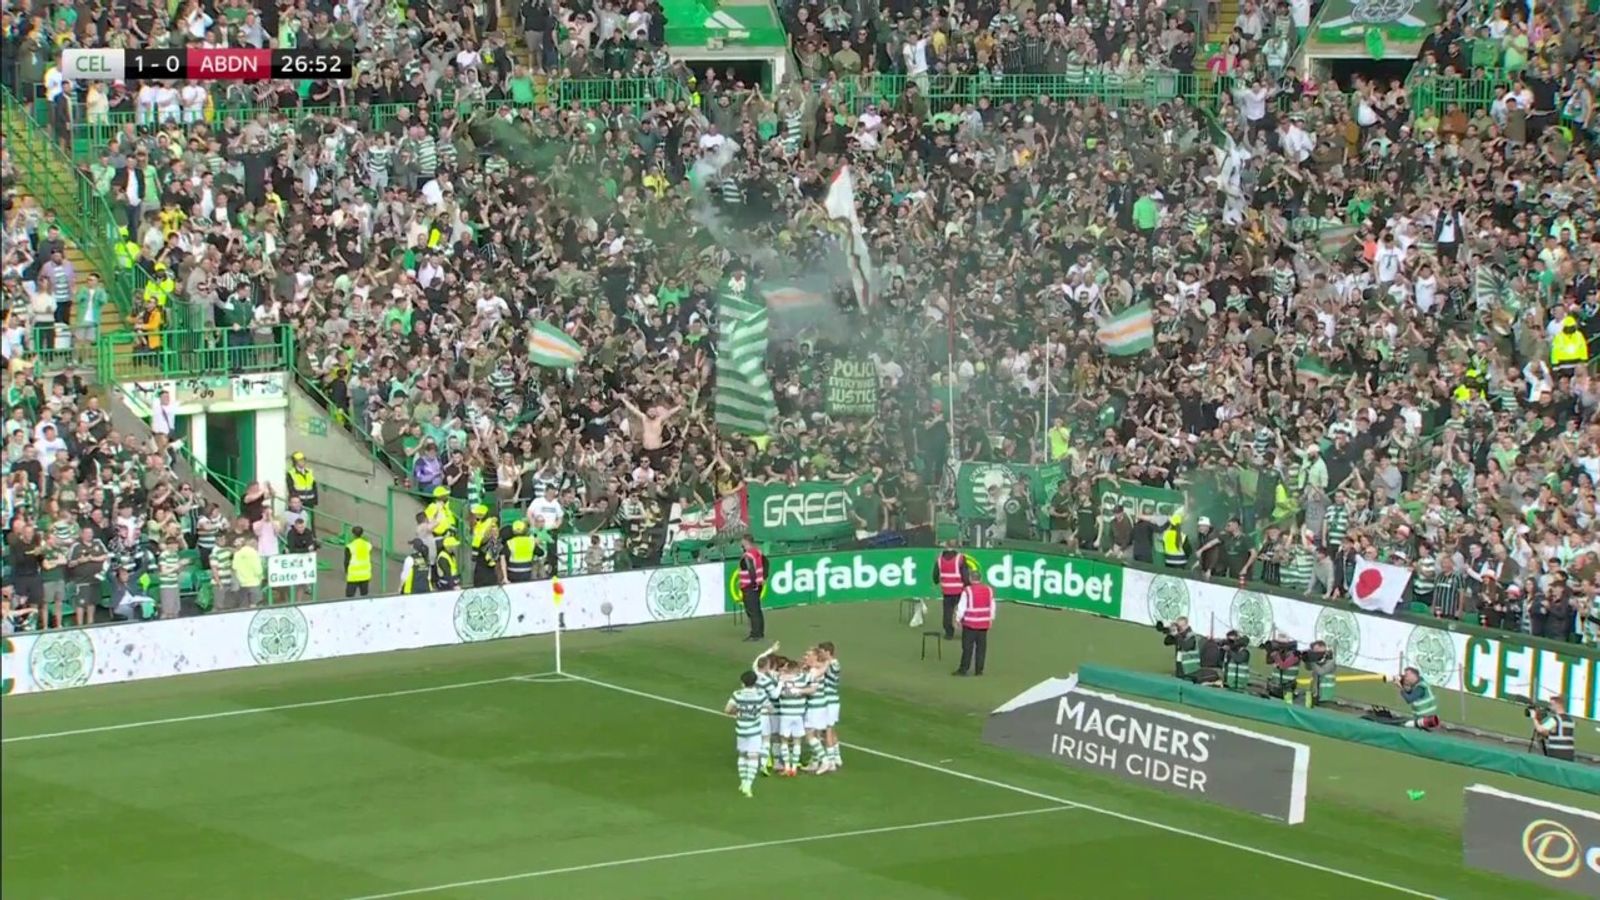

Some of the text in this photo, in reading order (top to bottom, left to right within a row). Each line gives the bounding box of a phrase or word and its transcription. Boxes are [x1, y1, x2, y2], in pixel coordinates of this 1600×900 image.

[270, 570, 315, 583] Gate 14
[281, 558, 304, 569] Exit
[771, 554, 917, 598] dafabet
[986, 554, 1113, 604] dafabet
[1055, 696, 1211, 763] MAGNERS
[1051, 733, 1208, 793] IRISH CIDER
